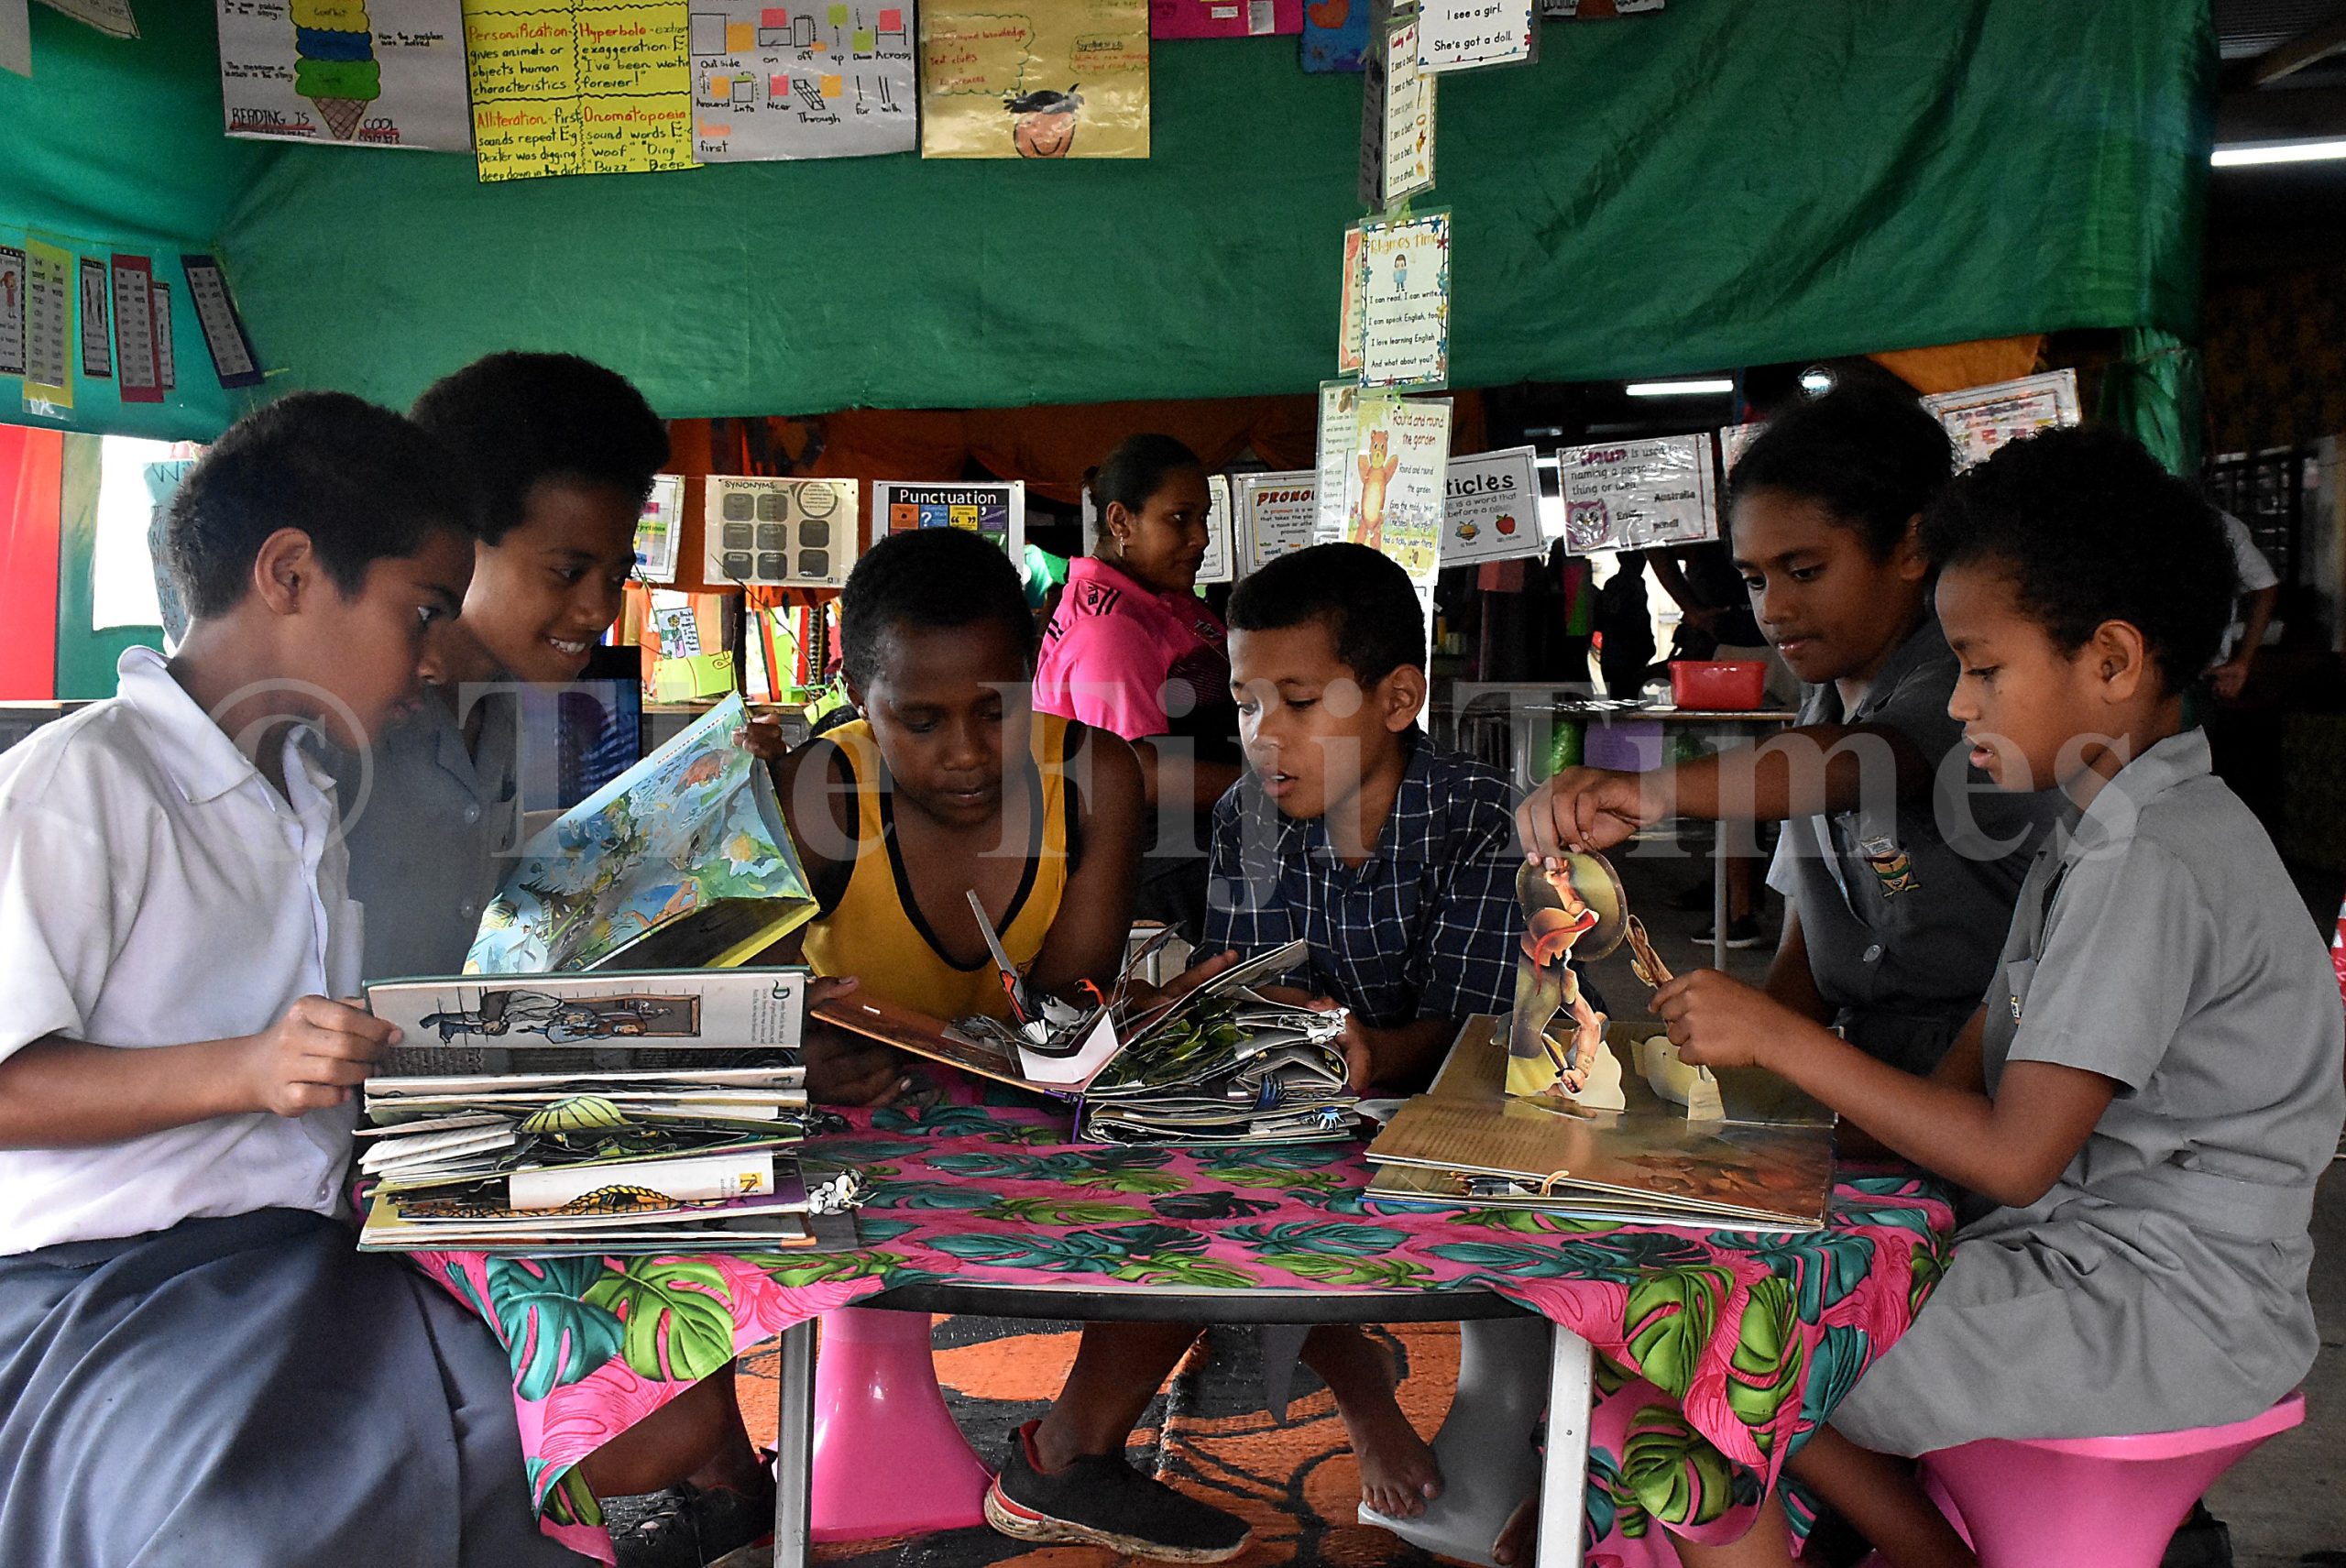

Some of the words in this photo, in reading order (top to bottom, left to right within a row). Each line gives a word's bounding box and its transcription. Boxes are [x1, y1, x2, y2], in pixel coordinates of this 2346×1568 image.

[1448, 9, 1450, 20] I
[1454, 11, 1470, 19] see
[1485, 4, 1501, 17] girl.
[1434, 40, 1460, 51] She's
[1464, 36, 1480, 49] got
[1495, 31, 1512, 42] doll.
[471, 49, 499, 64] gives
[503, 42, 544, 57] animals
[551, 47, 564, 55] or
[797, 53, 813, 61] off
[831, 55, 844, 66] up
[876, 52, 911, 60] Across
[473, 62, 513, 82] objects
[521, 61, 559, 73] human
[618, 60, 651, 71] been
[232, 108, 285, 126] READING
[364, 118, 395, 130] COOL
[554, 107, 580, 123] first
[696, 99, 730, 108] Around
[734, 104, 754, 113] Into
[767, 102, 790, 110] Near
[798, 113, 840, 125] Through
[881, 104, 902, 114] with
[478, 131, 513, 146] sounds
[587, 126, 622, 138] sound
[699, 140, 728, 152] first
[516, 152, 536, 160] was
[541, 146, 576, 164] digging
[481, 168, 504, 182] deep
[508, 167, 531, 180] down
[545, 164, 557, 175] the
[561, 164, 579, 175] dirt
[1387, 315, 1402, 324] speak
[1376, 337, 1387, 345] love
[1390, 336, 1412, 345] learning
[1400, 357, 1416, 366] about
[1419, 356, 1433, 366] you?
[1393, 411, 1411, 427] Round
[1411, 415, 1425, 427] and
[1426, 416, 1444, 428] round
[1413, 436, 1436, 450] garden
[1642, 448, 1665, 456] used
[1399, 463, 1412, 475] Round
[1421, 467, 1433, 476] round
[1571, 469, 1607, 480] naming
[725, 480, 775, 489] SYNONYMS
[1446, 475, 1514, 496] ticles
[1573, 485, 1597, 495] thing
[900, 489, 997, 504] Punctuation
[1417, 486, 1431, 499] garden
[1654, 490, 1695, 502] Australia
[1474, 496, 1496, 504] word
